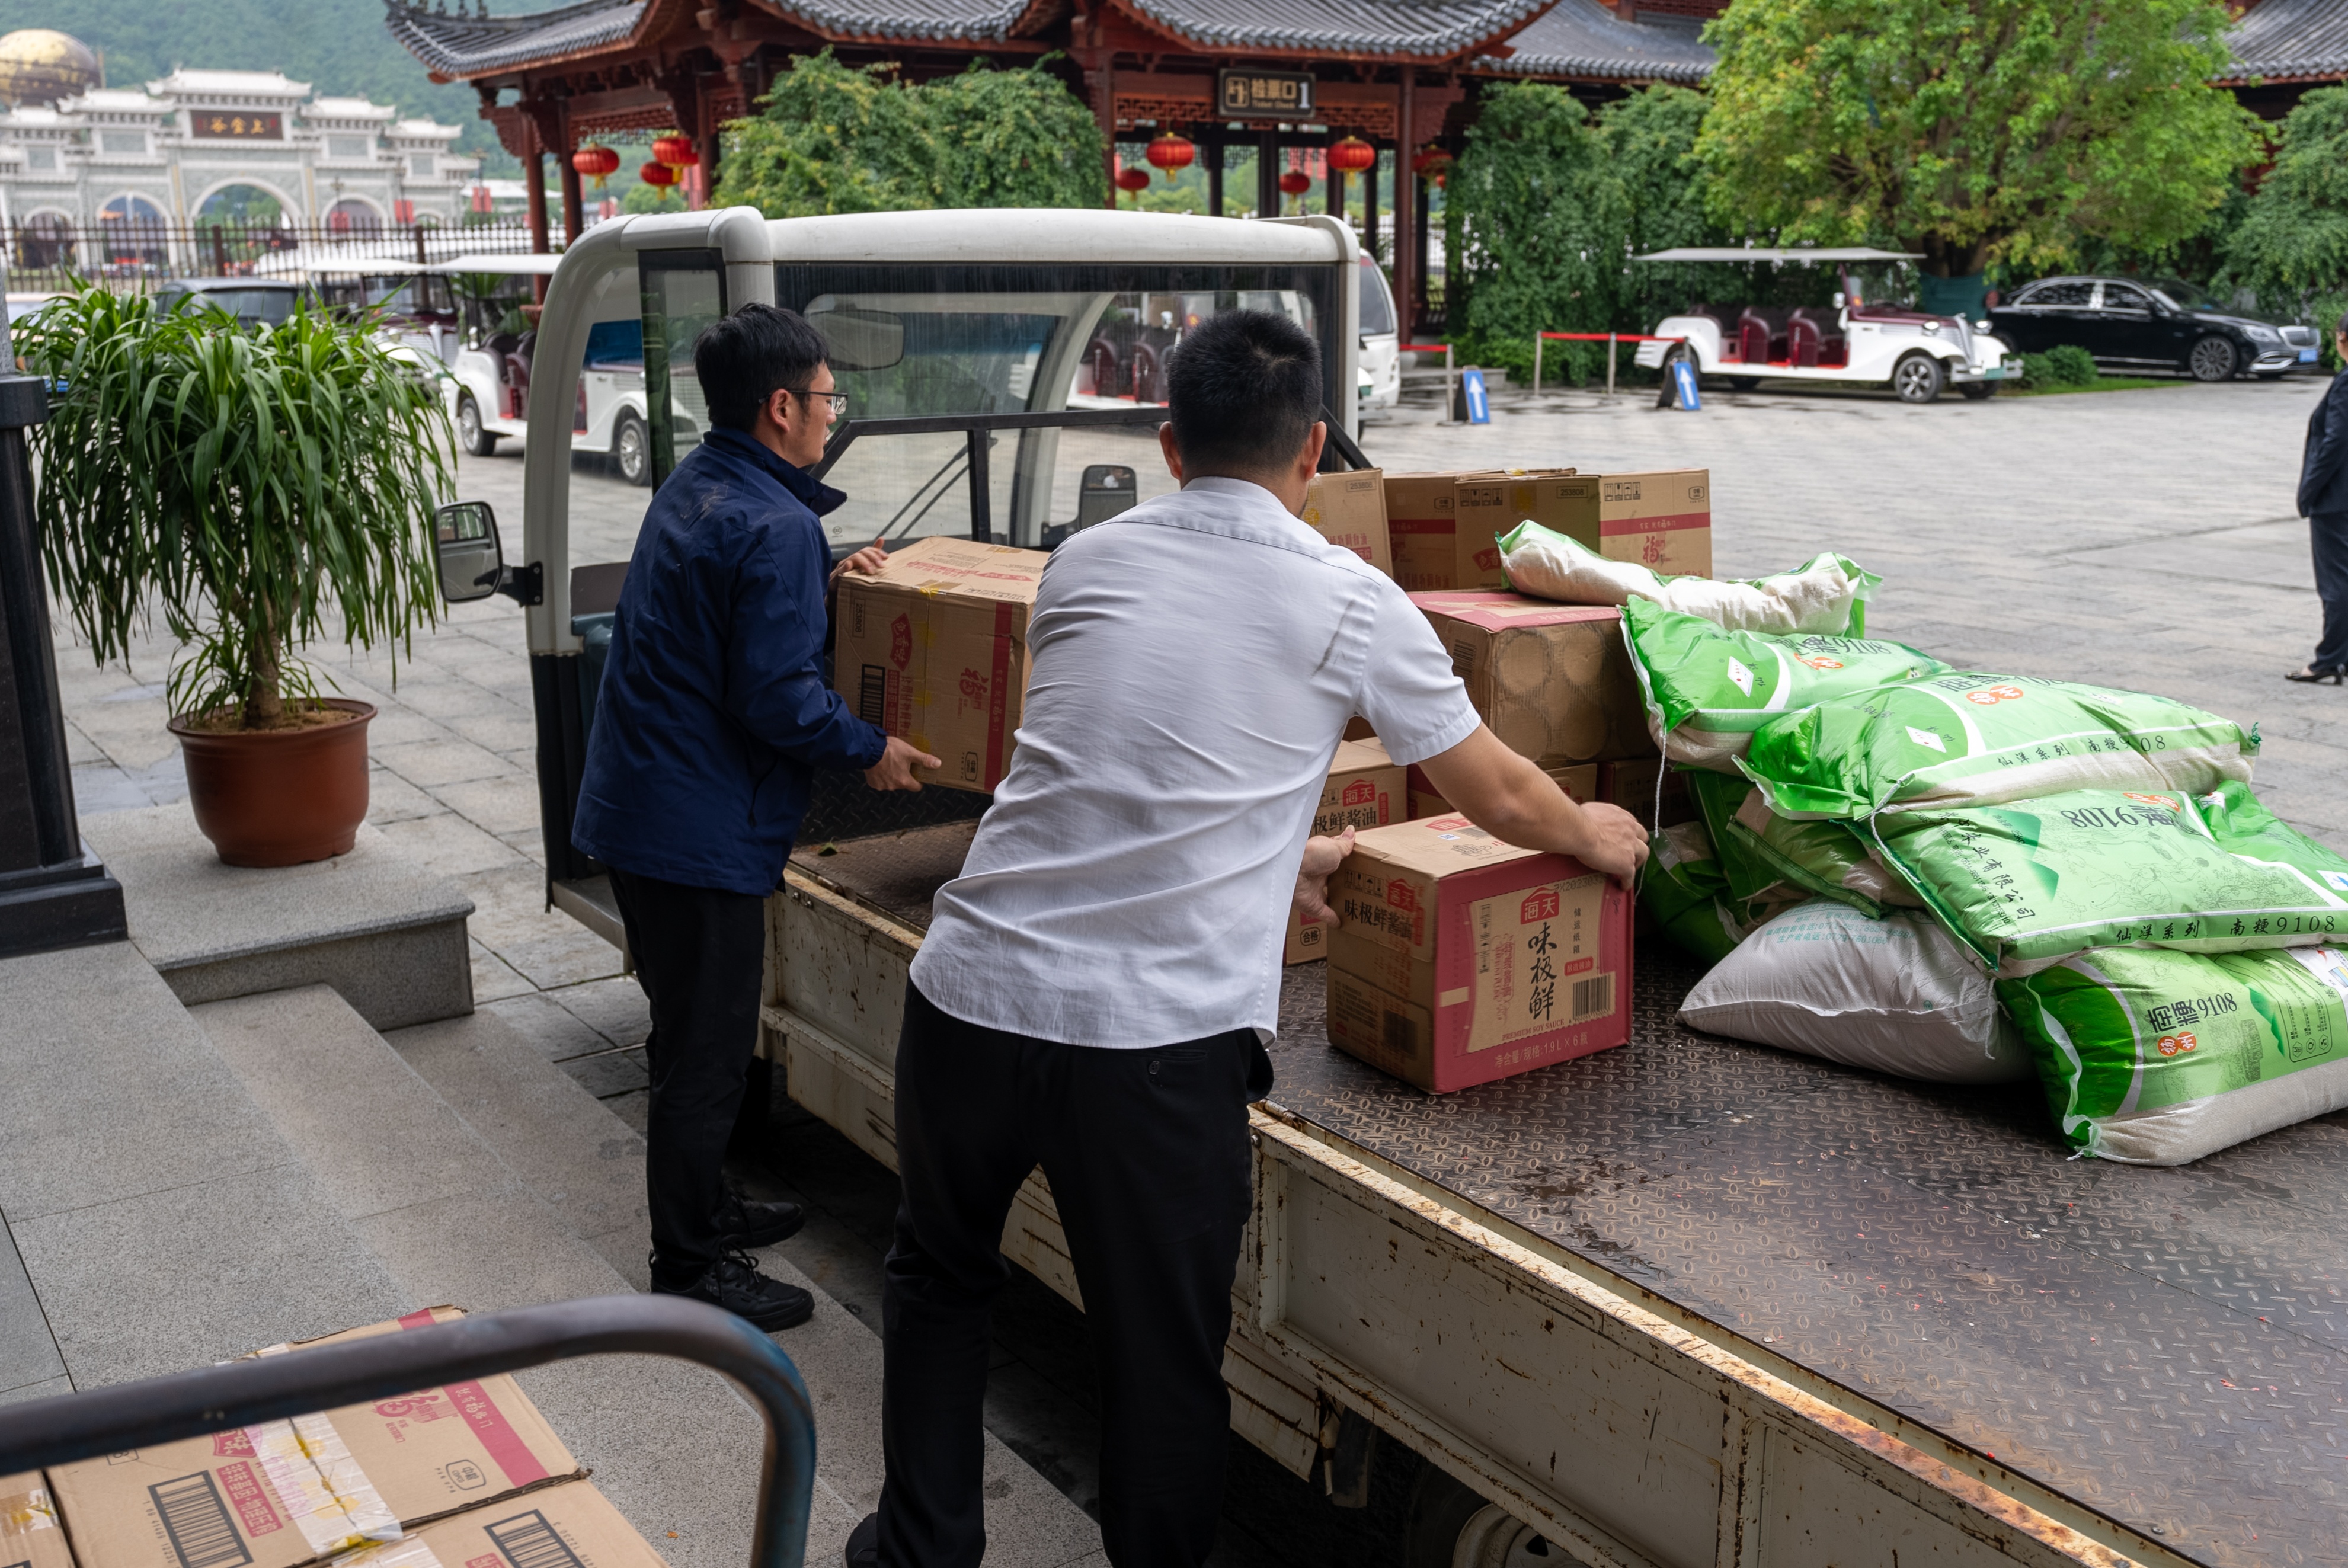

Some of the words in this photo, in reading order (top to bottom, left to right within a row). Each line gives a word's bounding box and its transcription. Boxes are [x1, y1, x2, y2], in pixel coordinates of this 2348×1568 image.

[1251, 78, 1297, 100] 检票口
[1299, 82, 1310, 109] 1
[1350, 481, 1373, 490] 253808
[893, 622, 909, 662] 色香味
[1998, 742, 2071, 767] 仙洋系列
[1345, 786, 1374, 804] 海天
[1310, 807, 1377, 834] 极鲜酱油
[1344, 899, 1413, 940] 味极鲜酱油
[1524, 896, 1556, 921] 海天
[1302, 930, 1319, 943] 合格
[2117, 920, 2200, 942] 仙洋系列
[2229, 916, 2334, 936] 南粳9108
[1528, 921, 1557, 1021] 味极鲜
[2147, 992, 2238, 1033] 南粳9108
[1502, 1028, 1531, 1041] PREMIUM
[1532, 1025, 1544, 1033] SOY
[1545, 1019, 1565, 1030] SAUCE
[2161, 1033, 2195, 1054] 扬州
[455, 1388, 494, 1428] 就有福临门
[462, 1467, 479, 1481] 中粮
